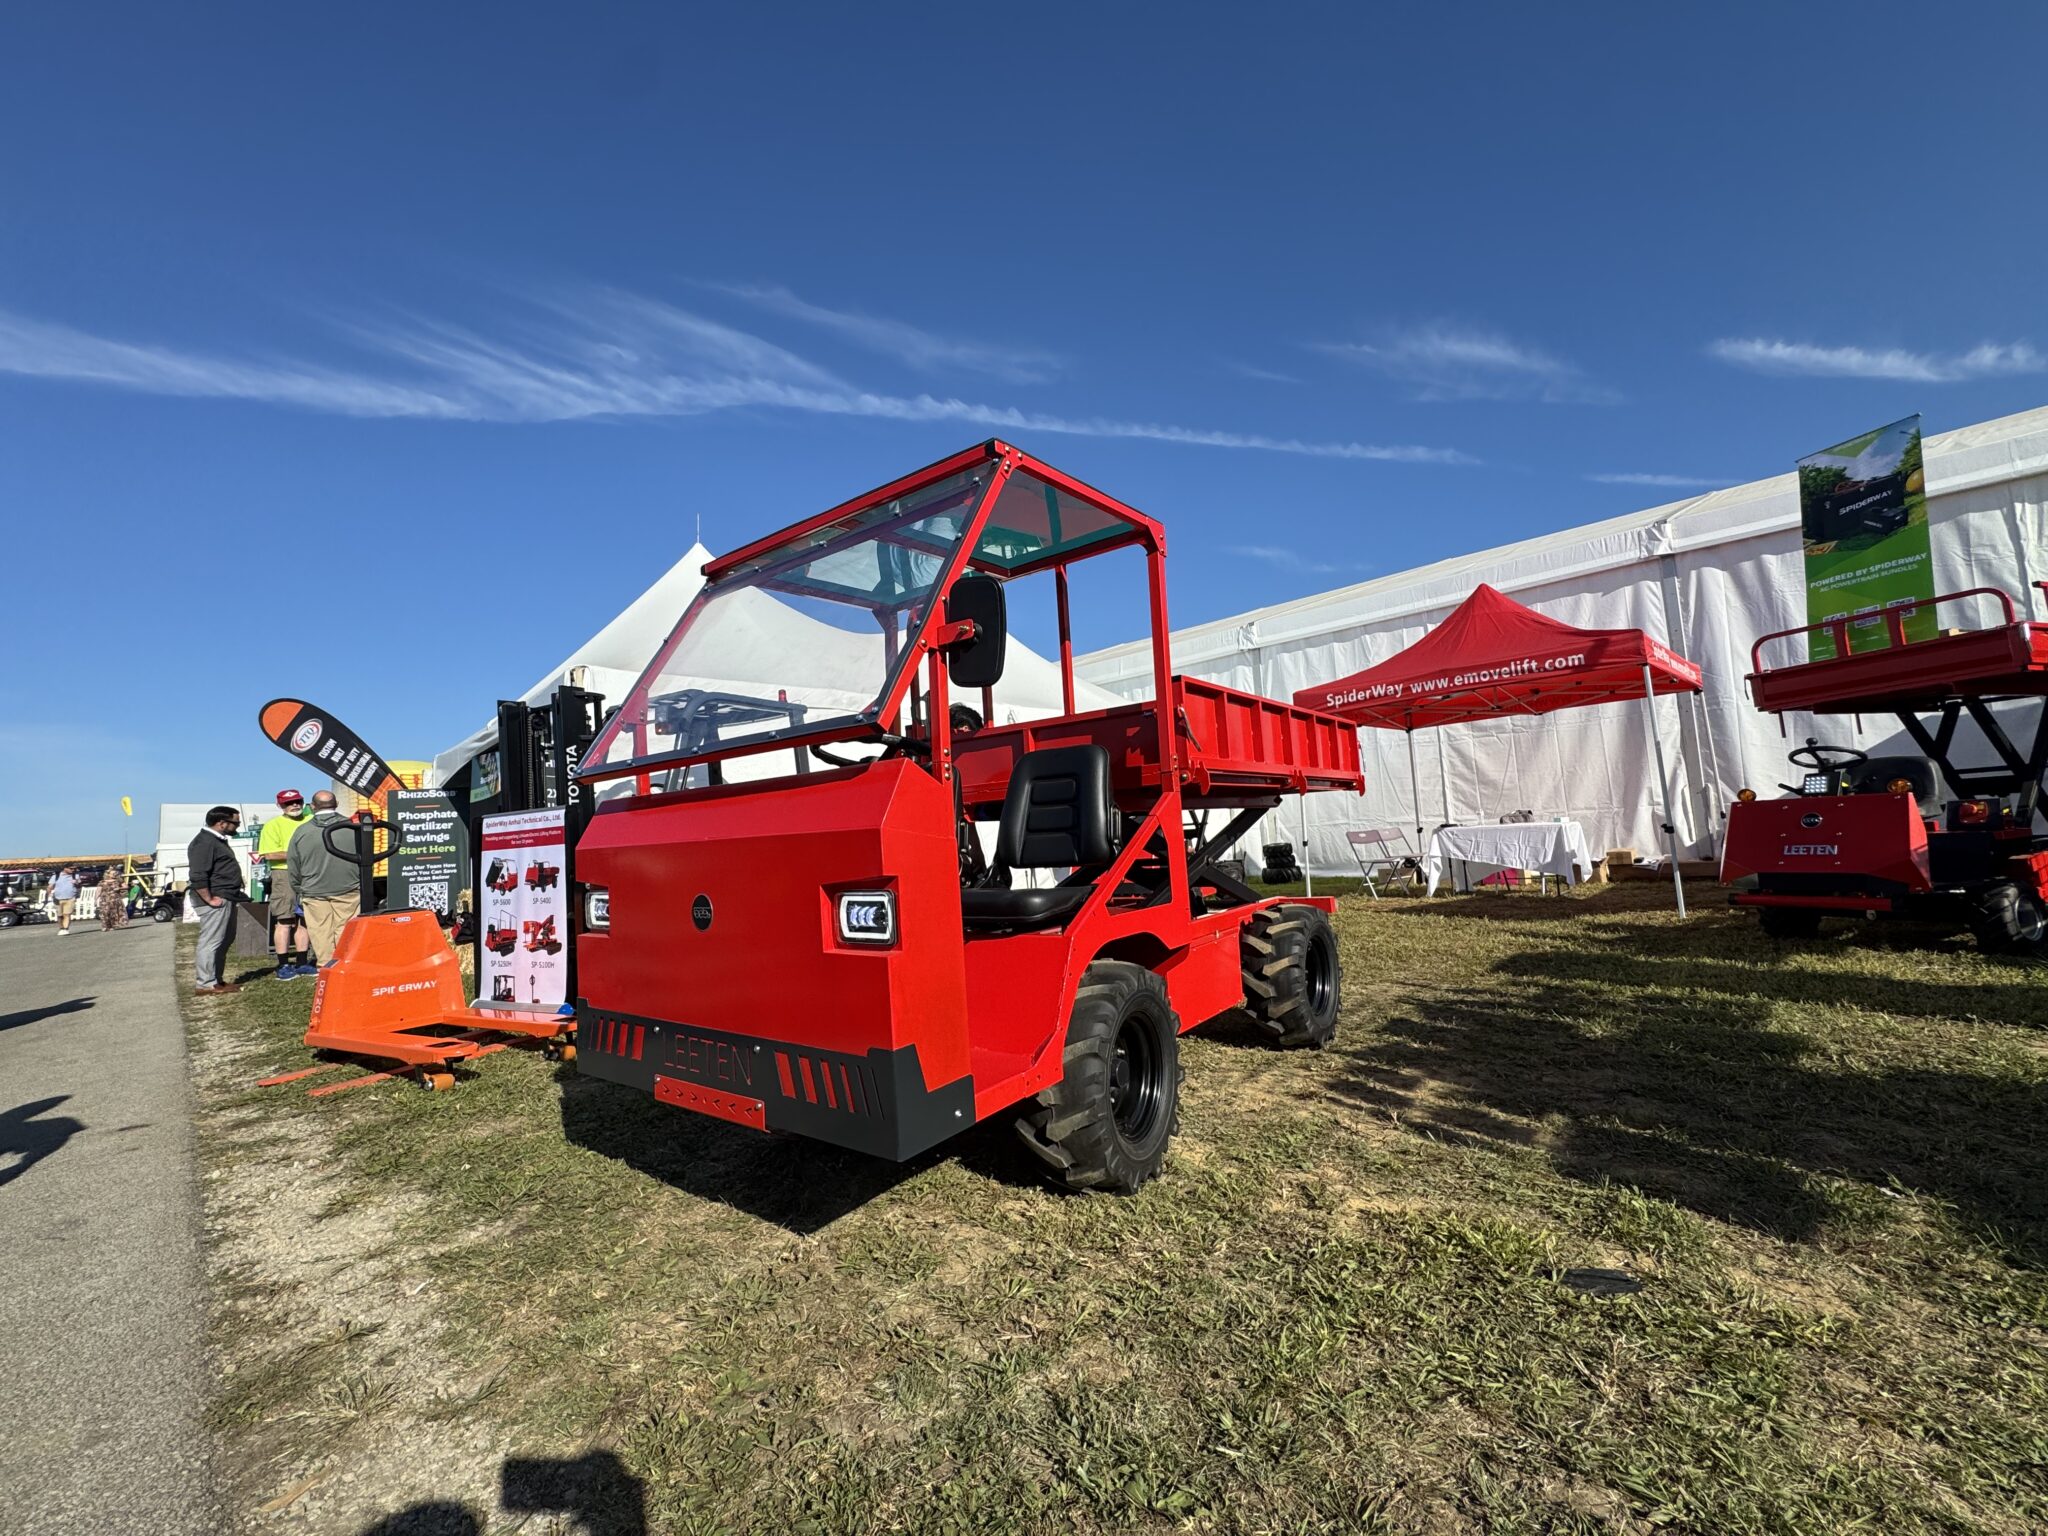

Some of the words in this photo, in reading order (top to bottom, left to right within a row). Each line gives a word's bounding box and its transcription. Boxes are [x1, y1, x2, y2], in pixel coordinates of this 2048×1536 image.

[1839, 489, 1893, 516] SPIDERWAY
[1810, 571, 1854, 588] POWERED
[1855, 568, 1868, 577] BY
[1869, 552, 1927, 573] SPIDERWAY
[1326, 682, 1404, 709] SpiderWay
[1409, 652, 1586, 694] www.emovelift.com
[318, 738, 337, 759] CUSTOM
[330, 747, 345, 763] BUILT
[336, 759, 352, 777] HEAVY
[347, 747, 360, 762] DUTY
[344, 752, 372, 786] AGRICULTURAL
[357, 761, 379, 788] MACHINERY
[398, 810, 458, 821] Phosphate
[485, 820, 508, 829] SpiderWay
[521, 816, 544, 824] Technical
[402, 821, 453, 832] Fertilizer
[406, 832, 450, 843] Savings
[398, 846, 428, 855] Start
[429, 845, 456, 854] Here
[1783, 844, 1838, 855] LEETEN
[663, 1031, 751, 1086] LEETEN
